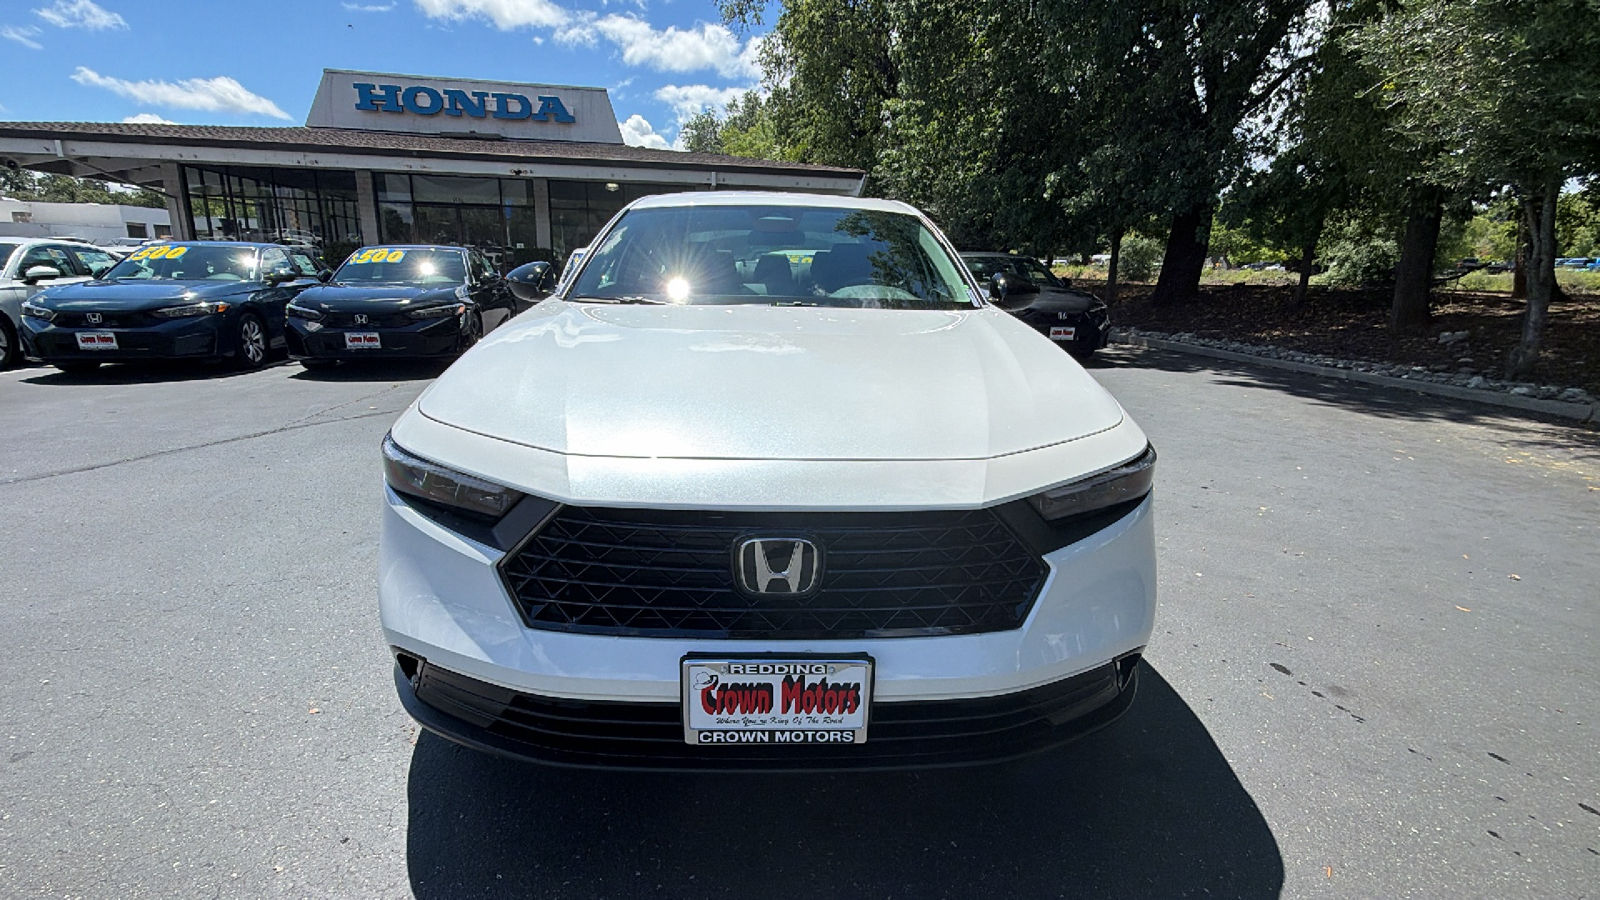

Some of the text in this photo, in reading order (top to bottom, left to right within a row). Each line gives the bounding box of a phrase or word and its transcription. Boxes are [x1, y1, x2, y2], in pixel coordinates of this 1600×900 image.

[353, 83, 576, 123] HONDA
[730, 664, 826, 674] REDDING
[701, 675, 860, 715] Crown Motors
[716, 716, 844, 727] Where You're King Of The Road
[700, 731, 854, 743] CROWN MOTORS
